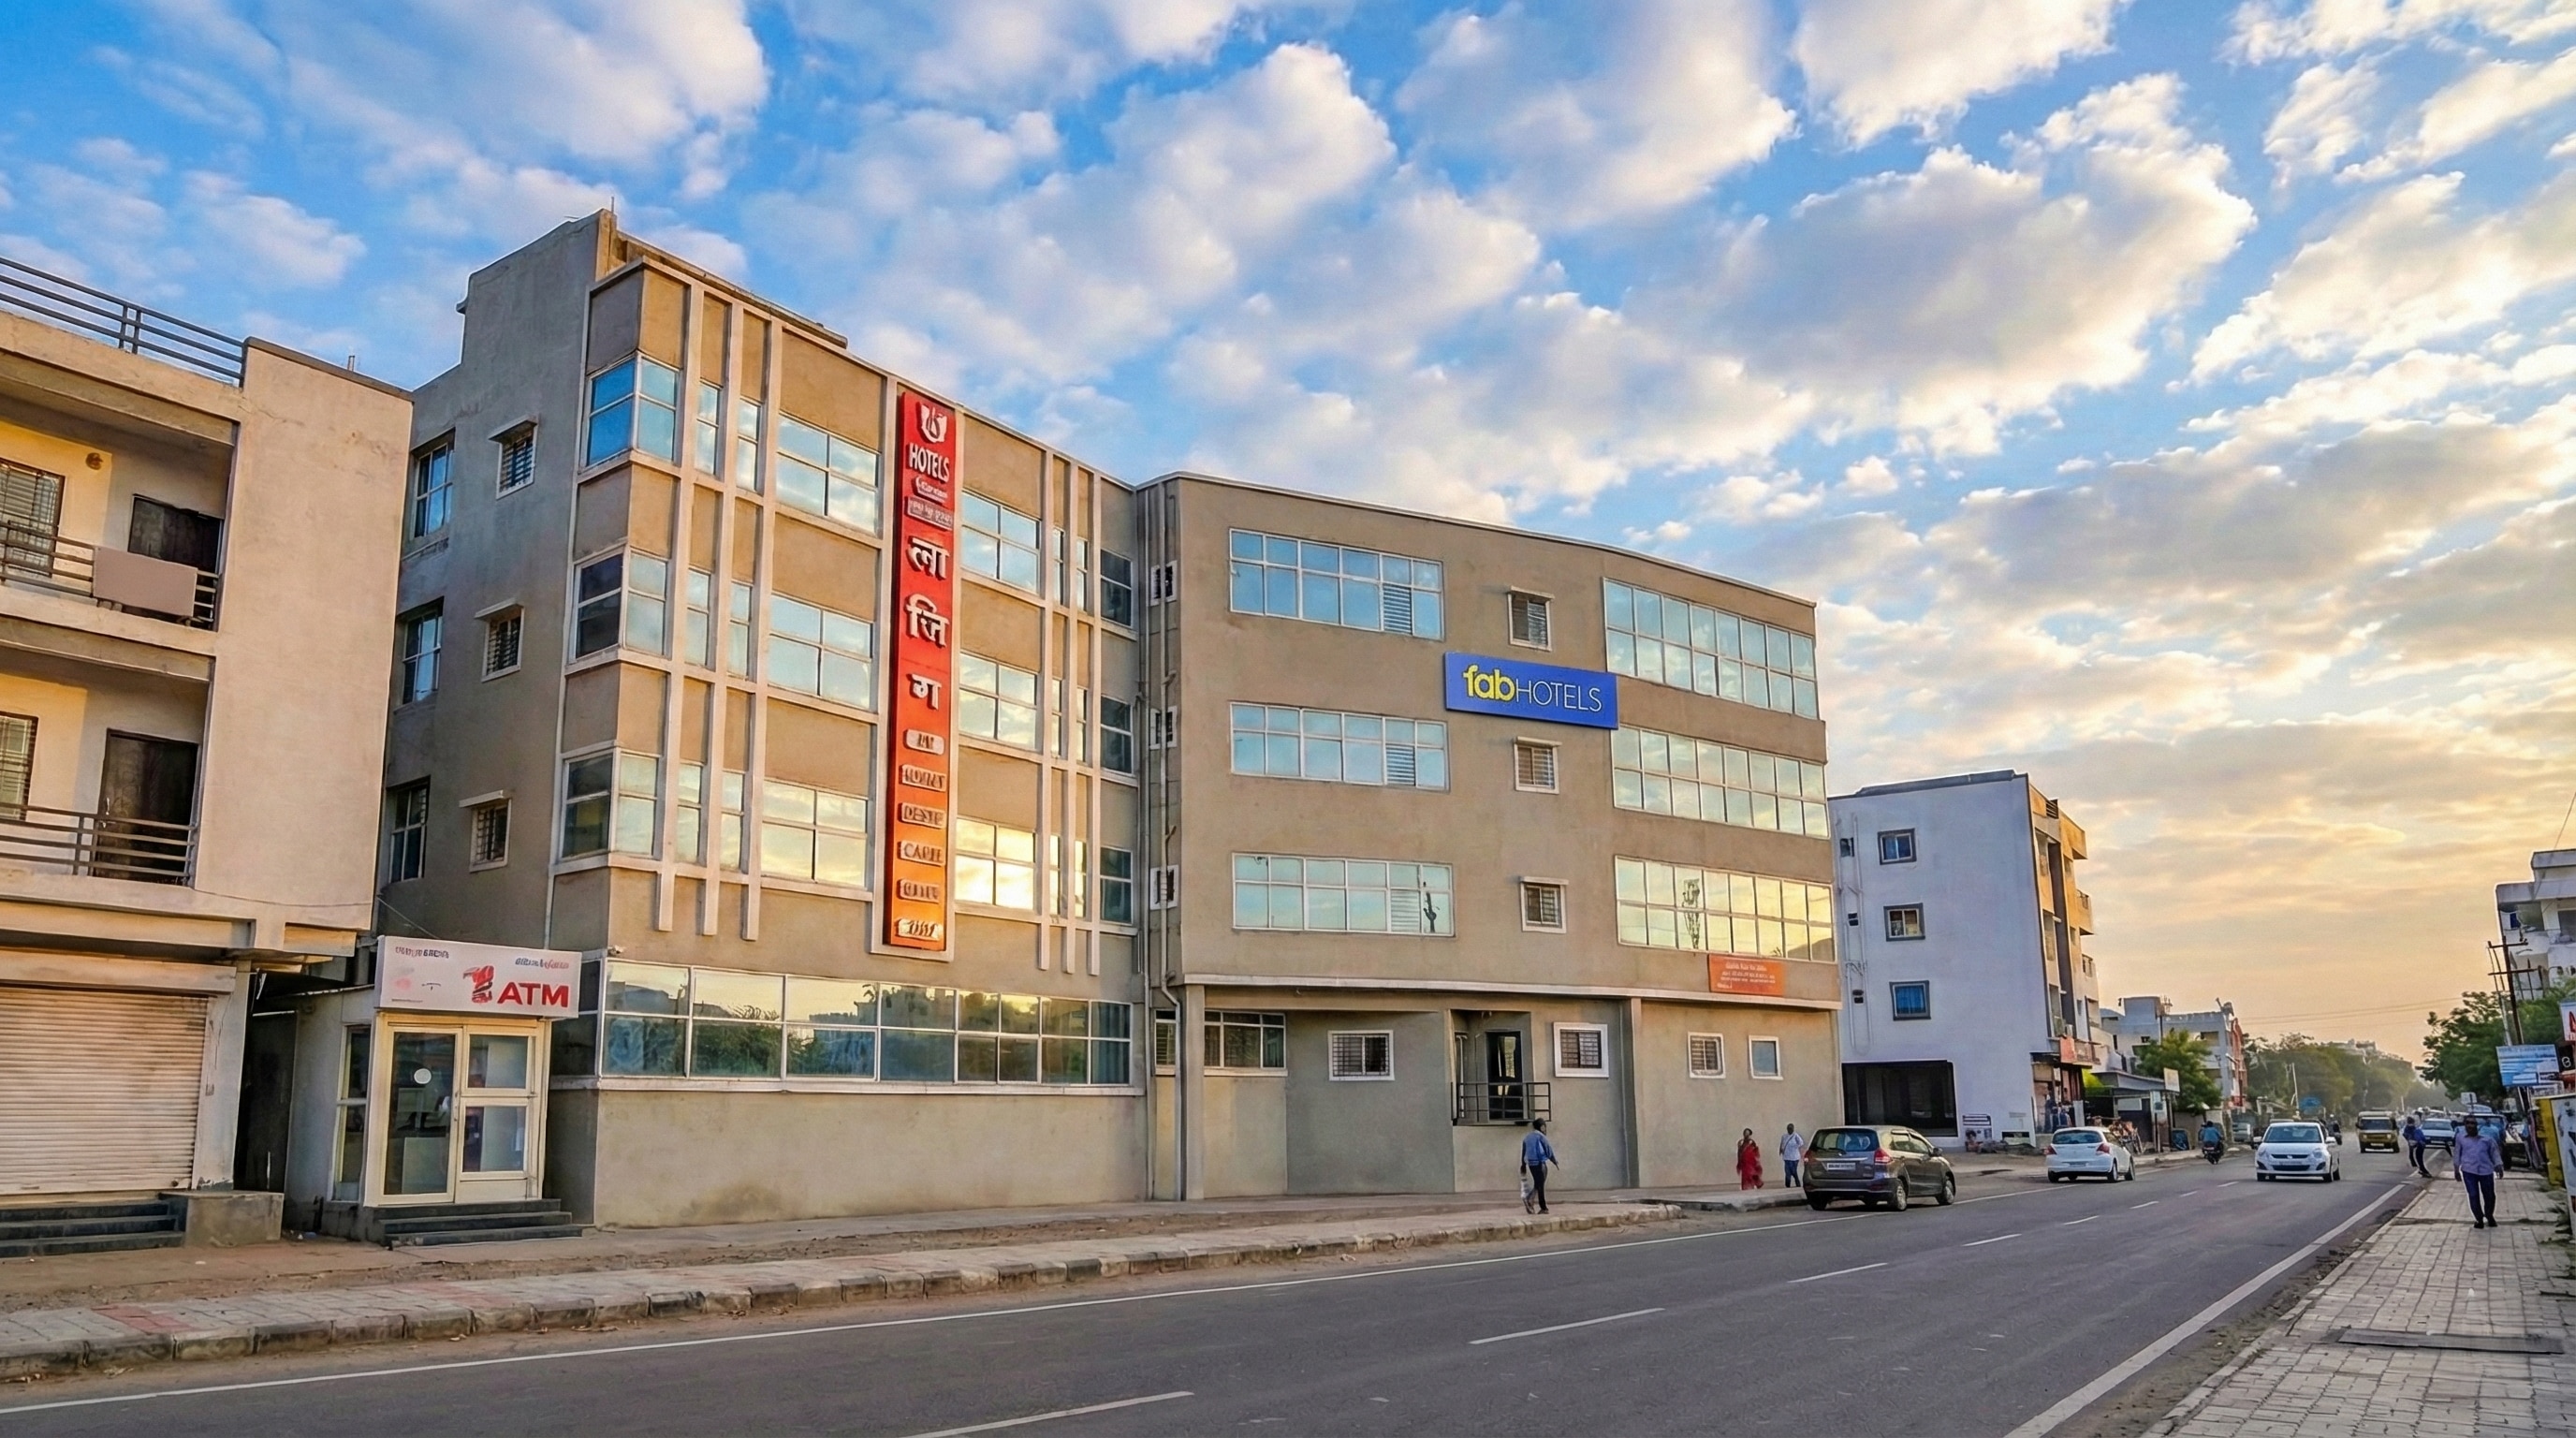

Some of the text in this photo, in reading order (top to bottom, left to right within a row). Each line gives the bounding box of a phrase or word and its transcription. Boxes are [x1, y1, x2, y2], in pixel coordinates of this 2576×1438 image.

[909, 442, 950, 483] HOTELS
[1463, 664, 1603, 712] fabHOTELS
[496, 981, 570, 1008] ATM
